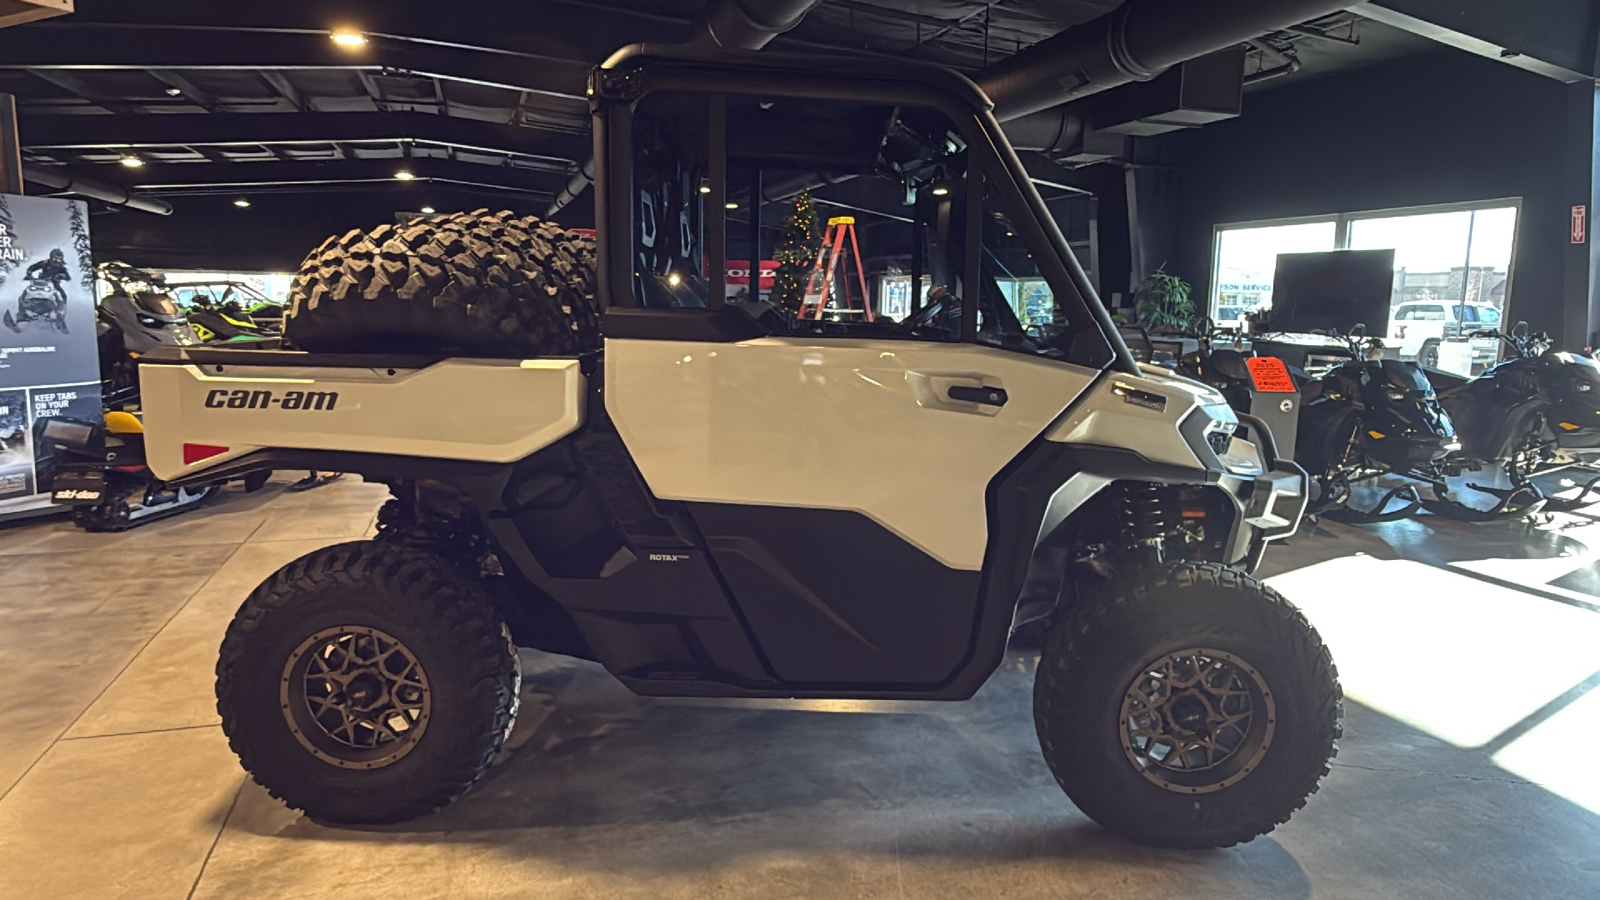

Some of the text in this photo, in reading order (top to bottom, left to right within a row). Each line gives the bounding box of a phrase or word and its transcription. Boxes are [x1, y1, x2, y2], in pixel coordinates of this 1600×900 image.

[35, 392, 77, 402] KEEP TABS
[204, 389, 338, 410] can-am
[35, 400, 69, 410] ON YOUR
[36, 409, 62, 418] CREW.
